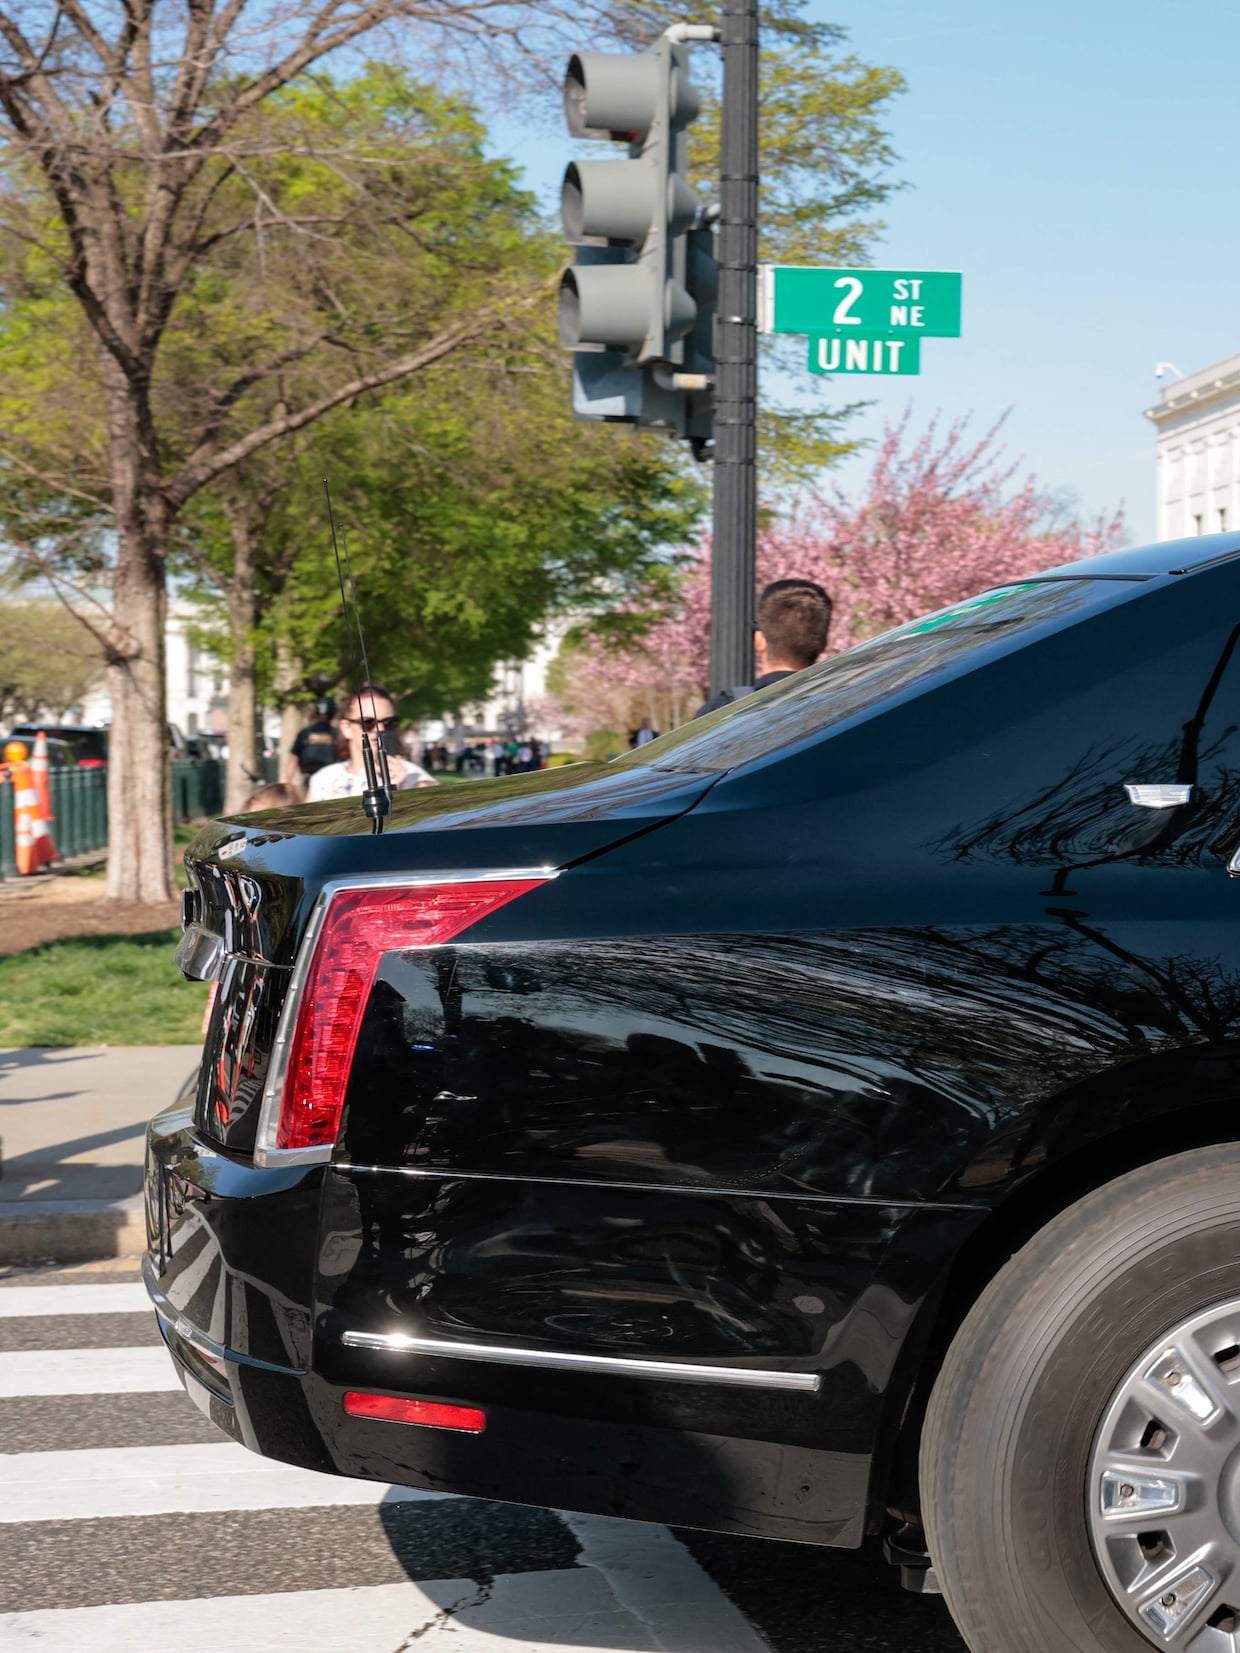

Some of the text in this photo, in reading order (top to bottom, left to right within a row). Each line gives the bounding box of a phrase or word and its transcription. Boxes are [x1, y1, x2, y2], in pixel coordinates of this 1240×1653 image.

[833, 277, 923, 325] 2 ST
[890, 306, 925, 327] NE
[818, 338, 905, 372] UNIT
